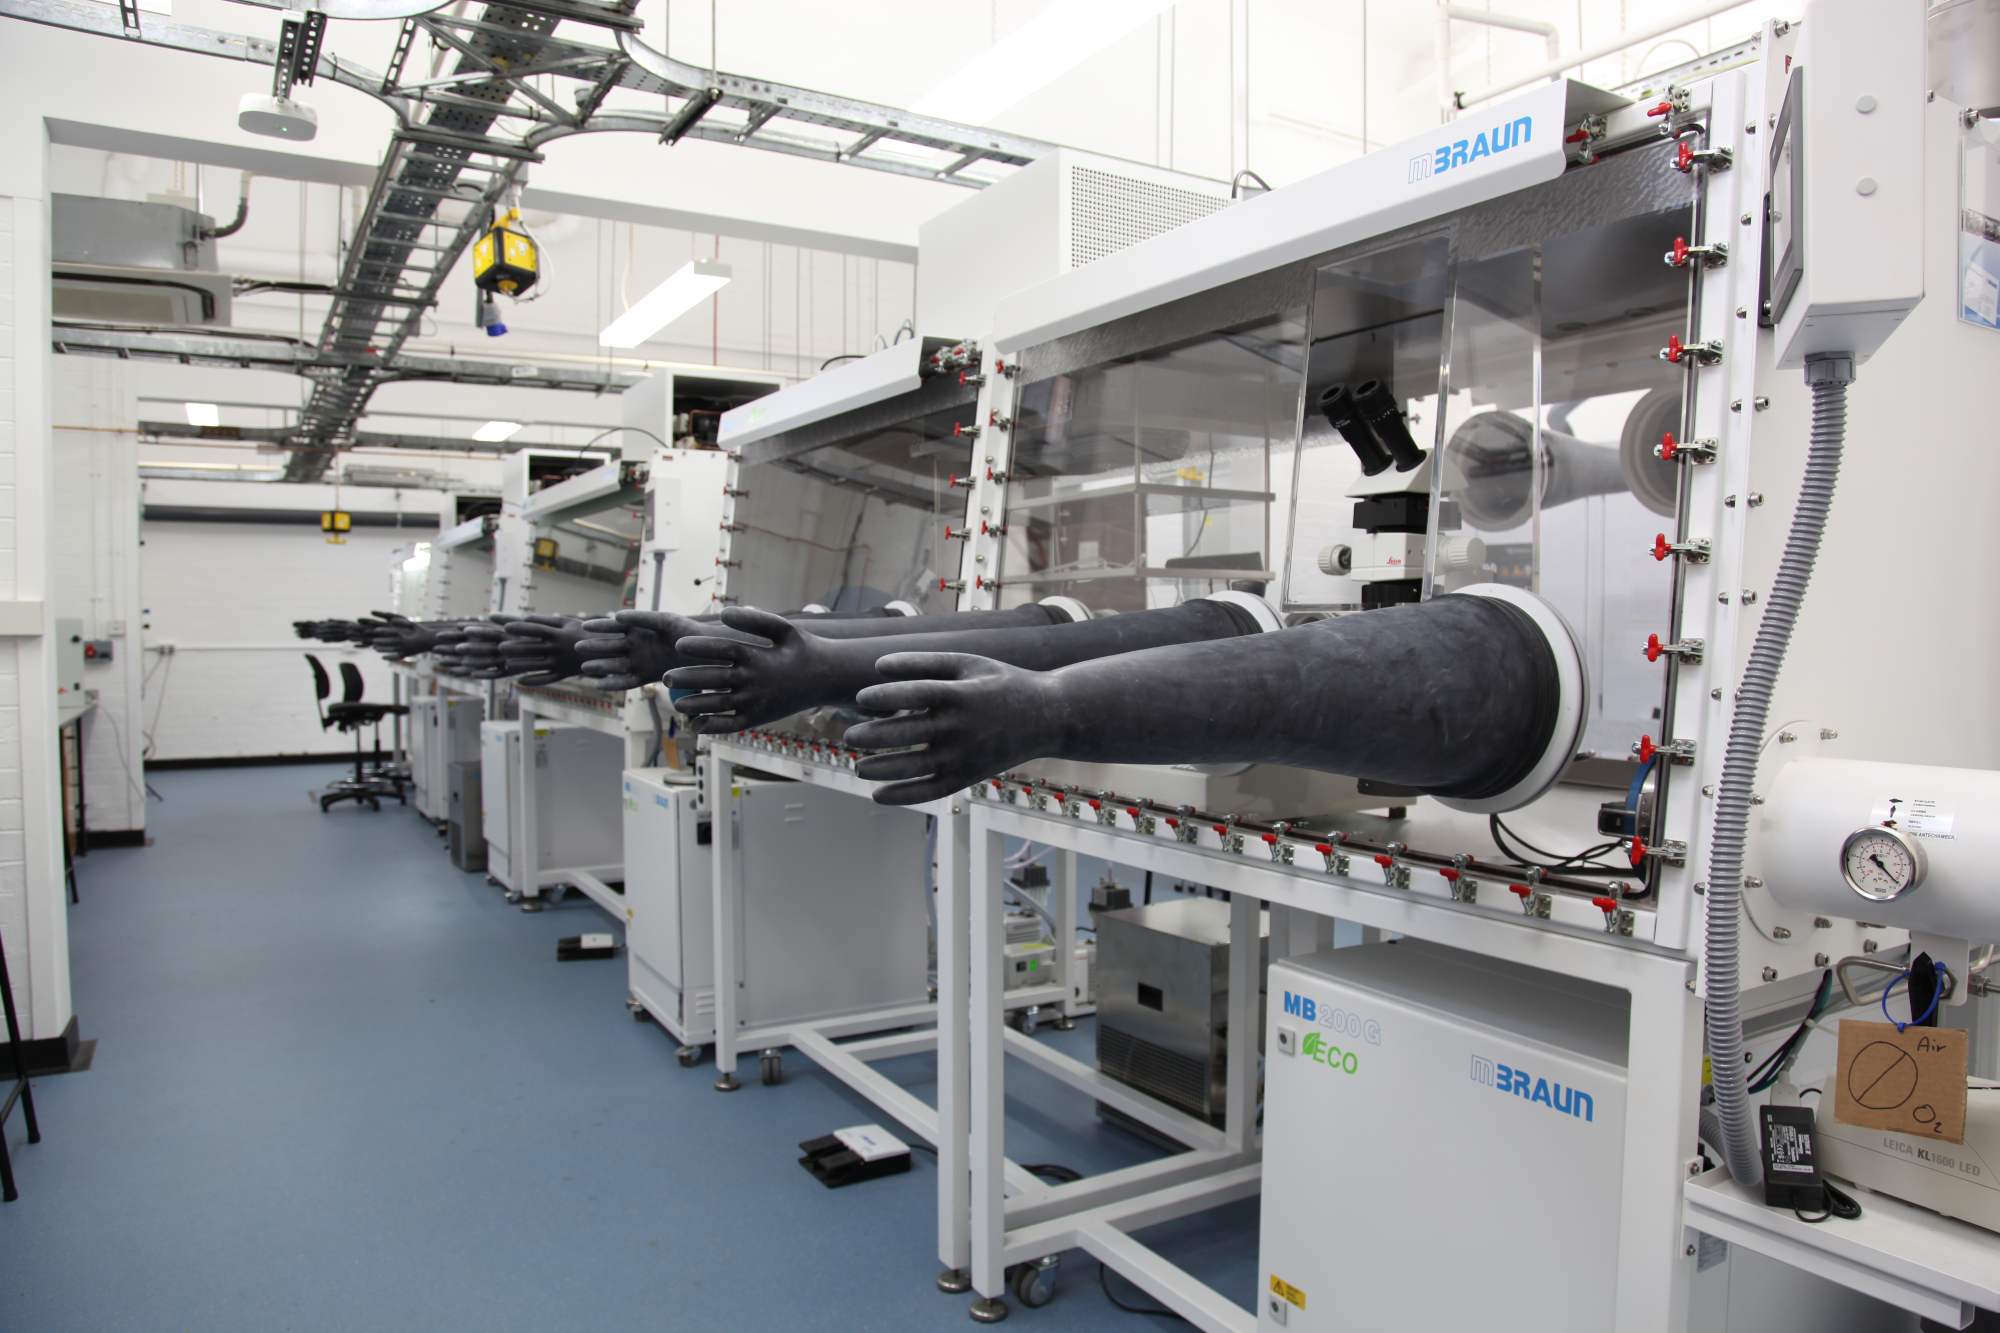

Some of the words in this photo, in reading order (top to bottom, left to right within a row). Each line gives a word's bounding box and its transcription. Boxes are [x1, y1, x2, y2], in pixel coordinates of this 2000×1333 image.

[1313, 1040, 1358, 1075] ECO
[1916, 1036, 1947, 1053] Air
[1883, 1138, 1913, 1156] LEICA
[1959, 1161, 1981, 1176] LED
